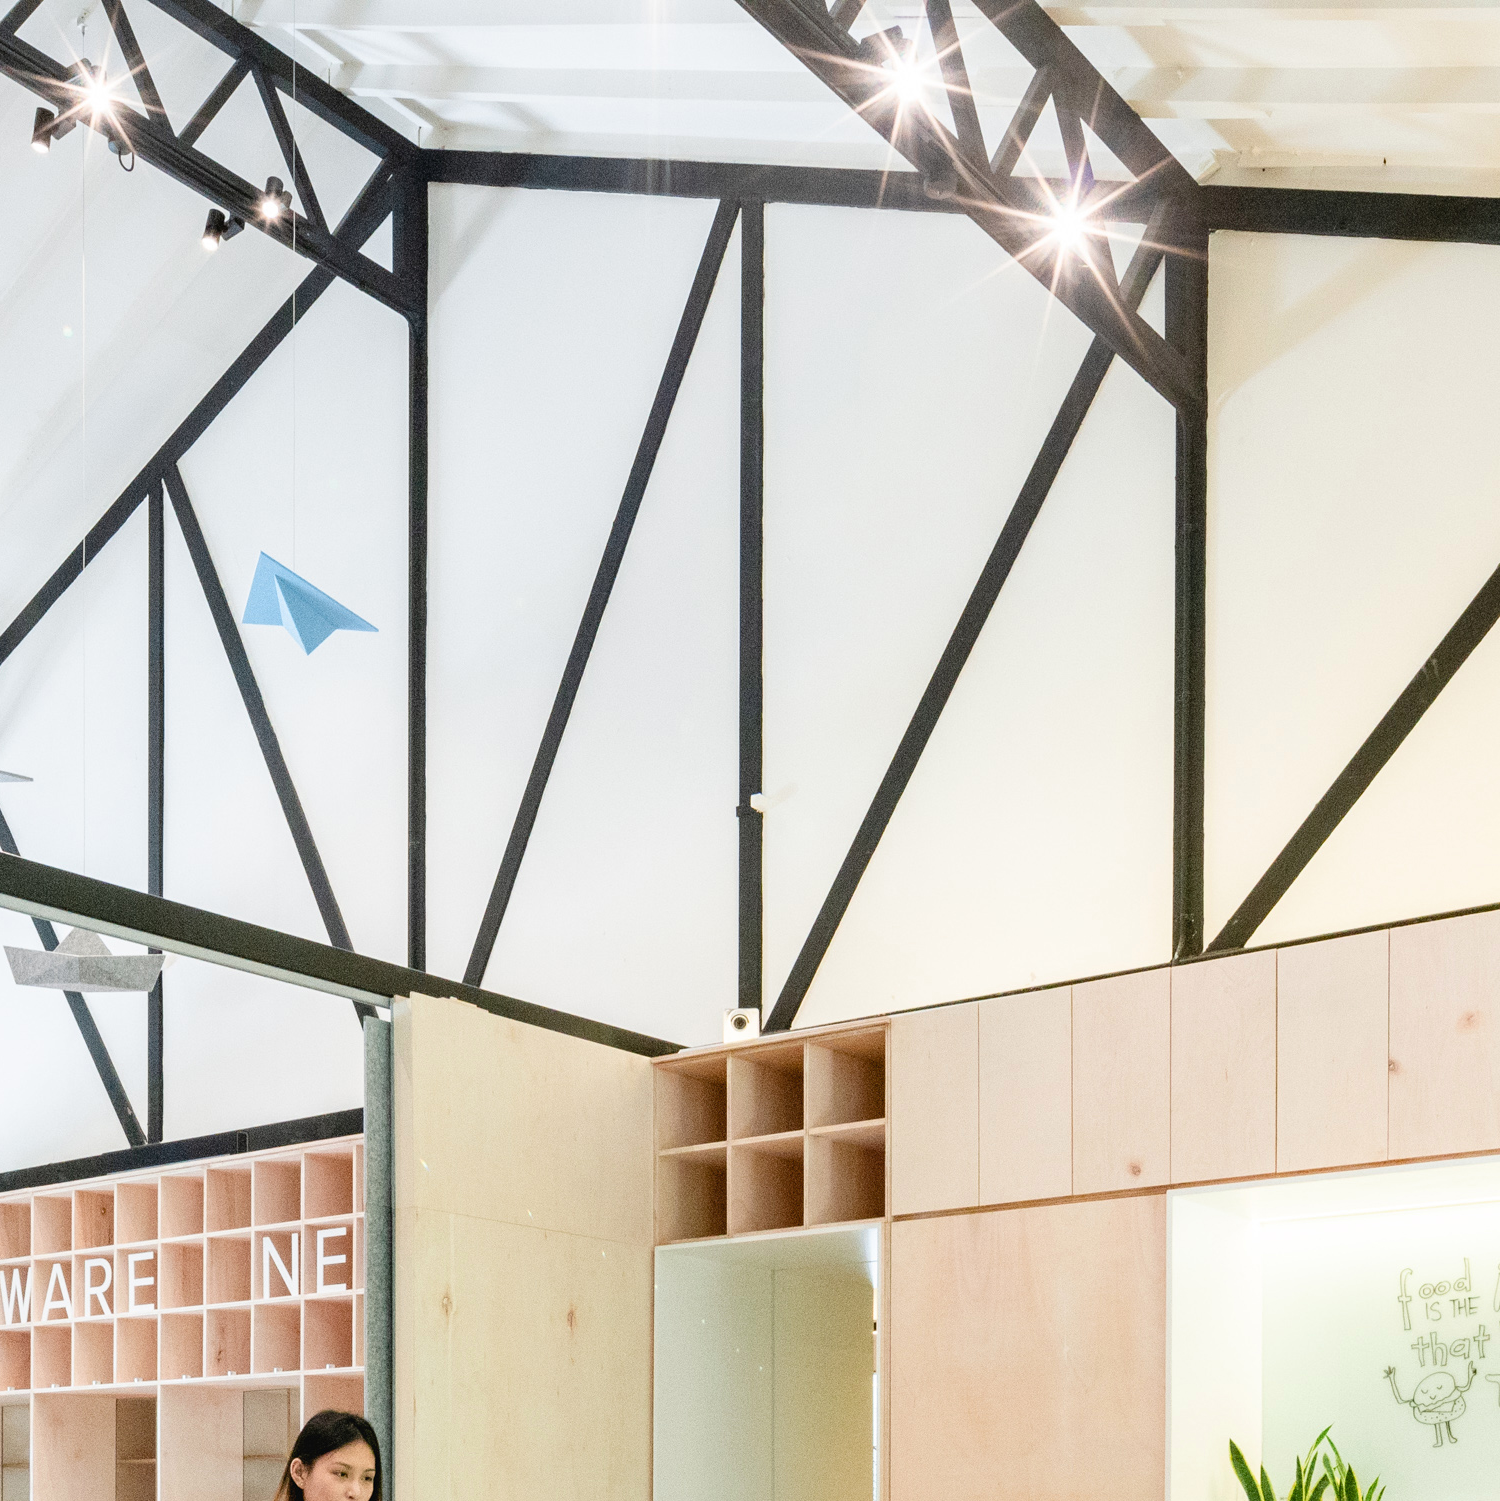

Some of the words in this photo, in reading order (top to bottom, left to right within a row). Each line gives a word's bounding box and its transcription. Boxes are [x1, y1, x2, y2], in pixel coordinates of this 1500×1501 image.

[1397, 1256, 1472, 1331] food
[1425, 1301, 1442, 1322] IS
[1449, 1295, 1481, 1318] THE
[1410, 1323, 1491, 1368] that
